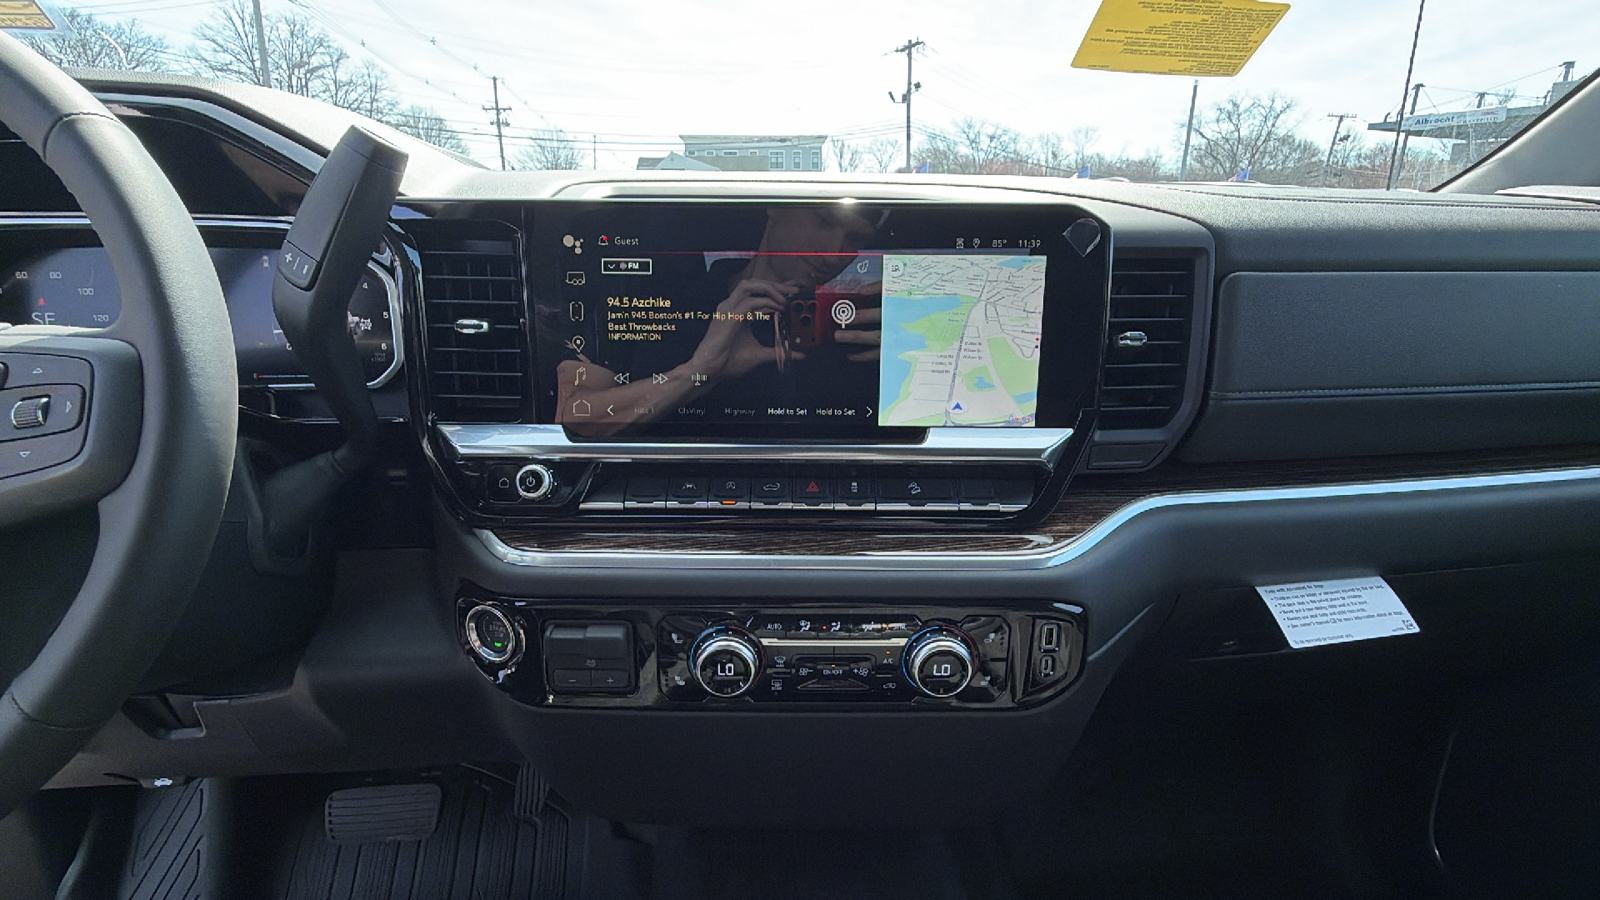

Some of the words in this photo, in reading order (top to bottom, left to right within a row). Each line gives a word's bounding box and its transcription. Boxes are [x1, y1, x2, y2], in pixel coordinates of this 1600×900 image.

[614, 236, 640, 246] Guest
[1018, 239, 1041, 248] 11:39
[627, 262, 640, 270] FM
[15, 271, 28, 279] 60
[49, 271, 62, 279] 80
[77, 287, 95, 296] 100
[606, 297, 630, 308] 94.5
[631, 296, 672, 308] Azchike
[92, 314, 110, 322] 120
[649, 311, 683, 320] Boston's
[684, 311, 694, 320] #1
[696, 311, 711, 320] For
[712, 311, 726, 322] Hip
[727, 312, 745, 323] Hop
[746, 312, 754, 320] &
[754, 311, 771, 321] The
[608, 322, 627, 331] Best
[628, 322, 677, 331] Throwbacks
[607, 333, 662, 341] INFORMATION
[724, 407, 756, 417] Highway
[767, 407, 785, 415] Hold
[786, 407, 795, 415] to
[796, 407, 808, 416] Set
[815, 408, 833, 416] Hold
[834, 408, 843, 416] to
[843, 408, 856, 416] Set
